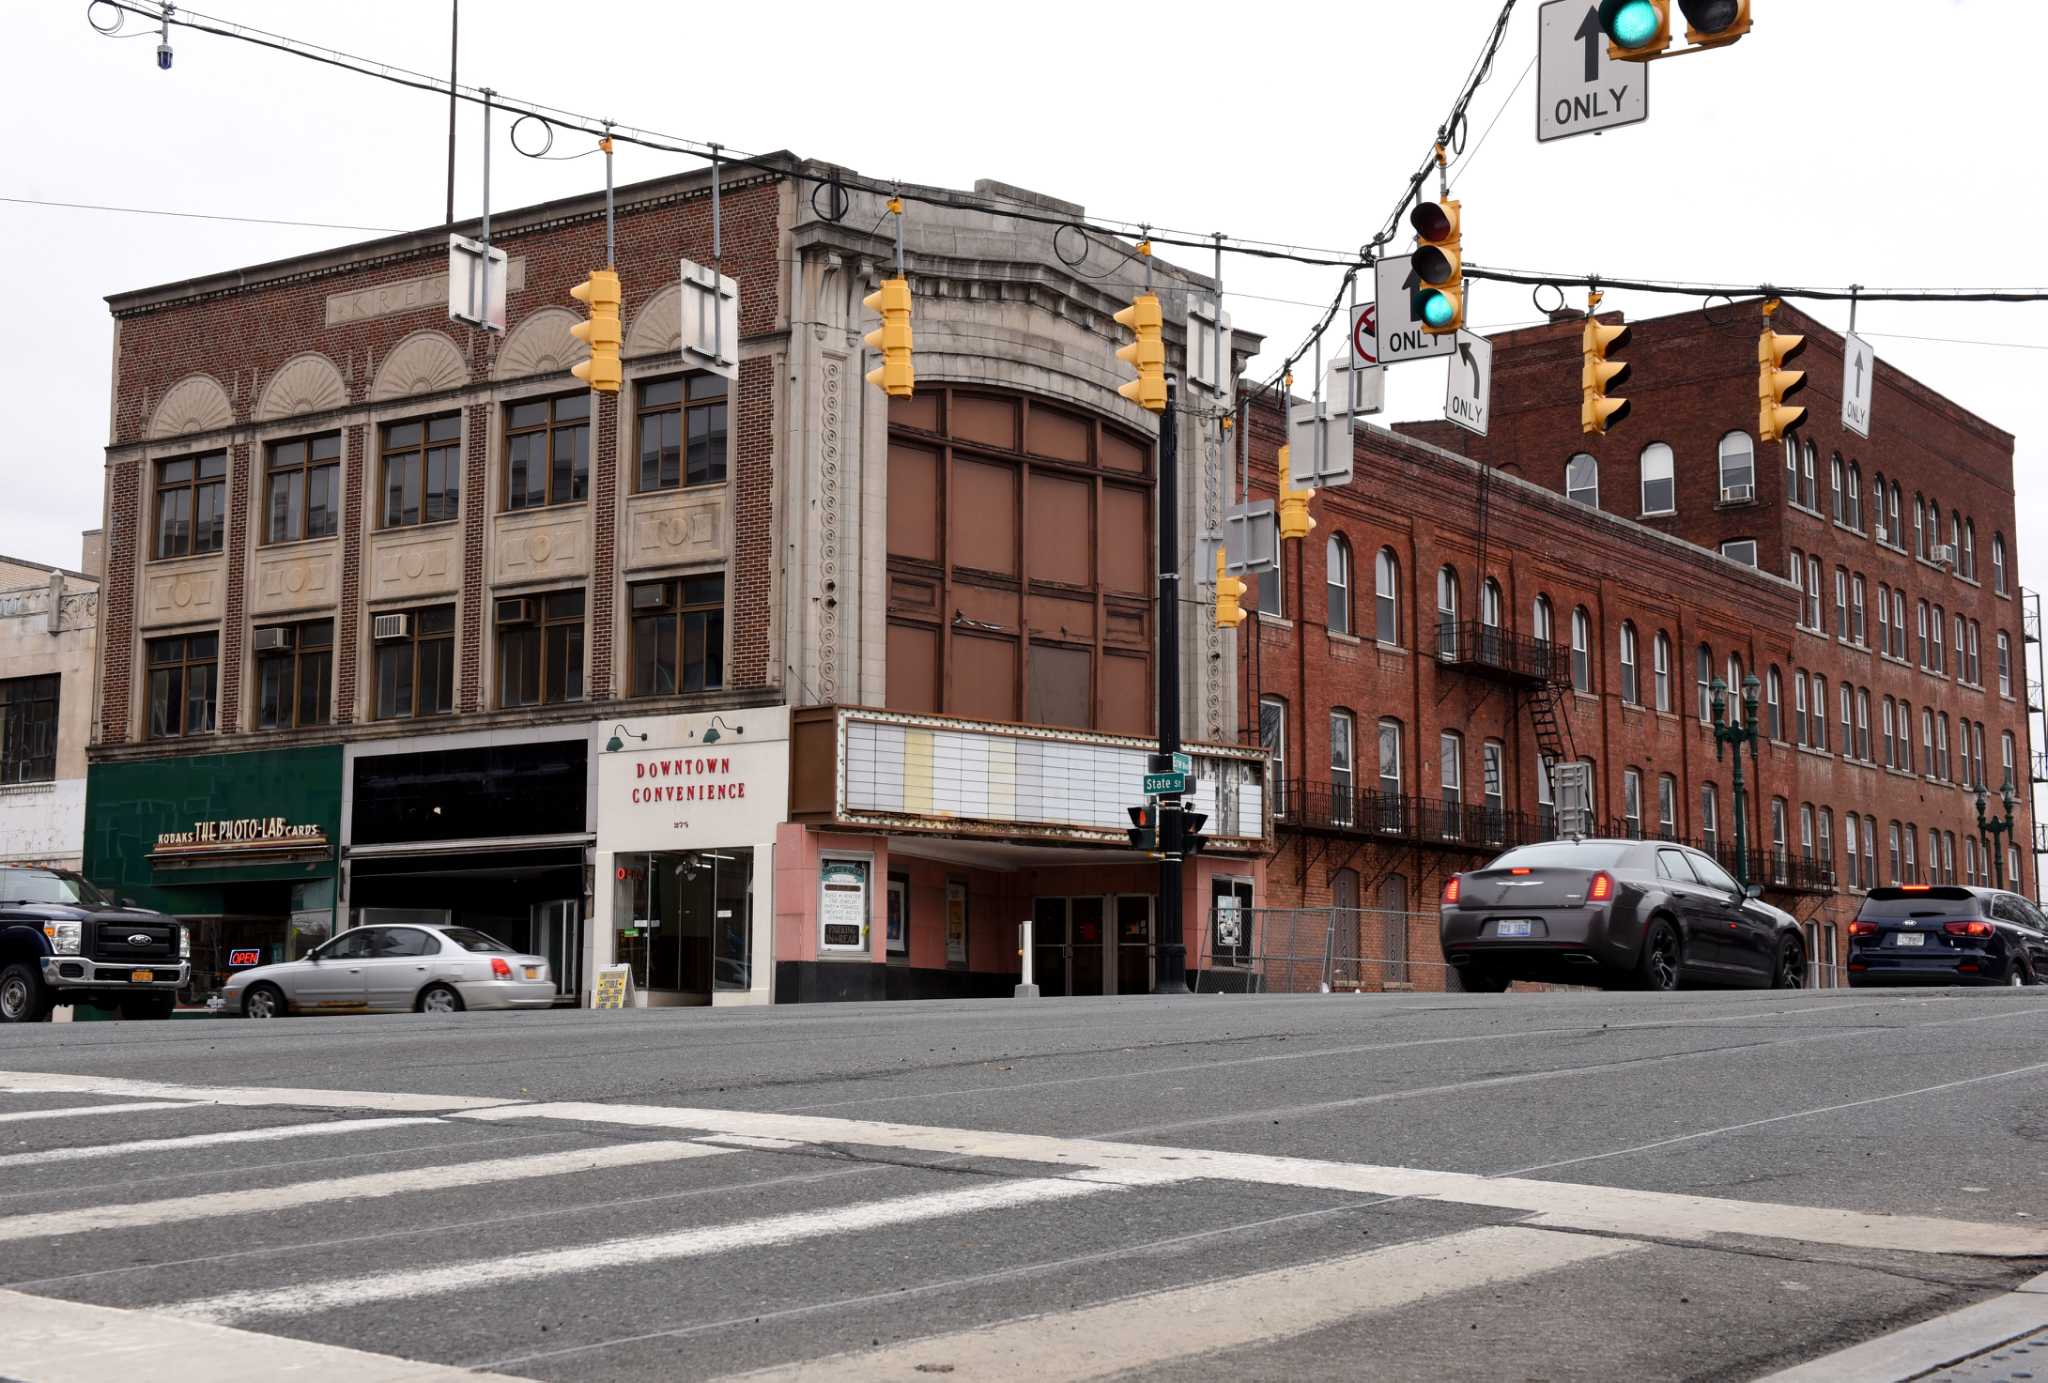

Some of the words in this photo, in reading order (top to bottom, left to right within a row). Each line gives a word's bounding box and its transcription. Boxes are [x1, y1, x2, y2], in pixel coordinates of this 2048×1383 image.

[1555, 84, 1628, 125] ONLY
[352, 278, 443, 314] KRES
[1452, 396, 1482, 423] ONLY
[1847, 400, 1866, 426] ONLY
[636, 758, 730, 779] DOWNTOWN
[632, 783, 745, 803] CONVENIENCE
[1146, 778, 1171, 790] State
[158, 832, 193, 844] KODAKS
[195, 821, 216, 842] THE
[219, 817, 285, 842] PHOTO-LAB
[285, 824, 318, 837] CARDS
[232, 952, 257, 964] OPEN
